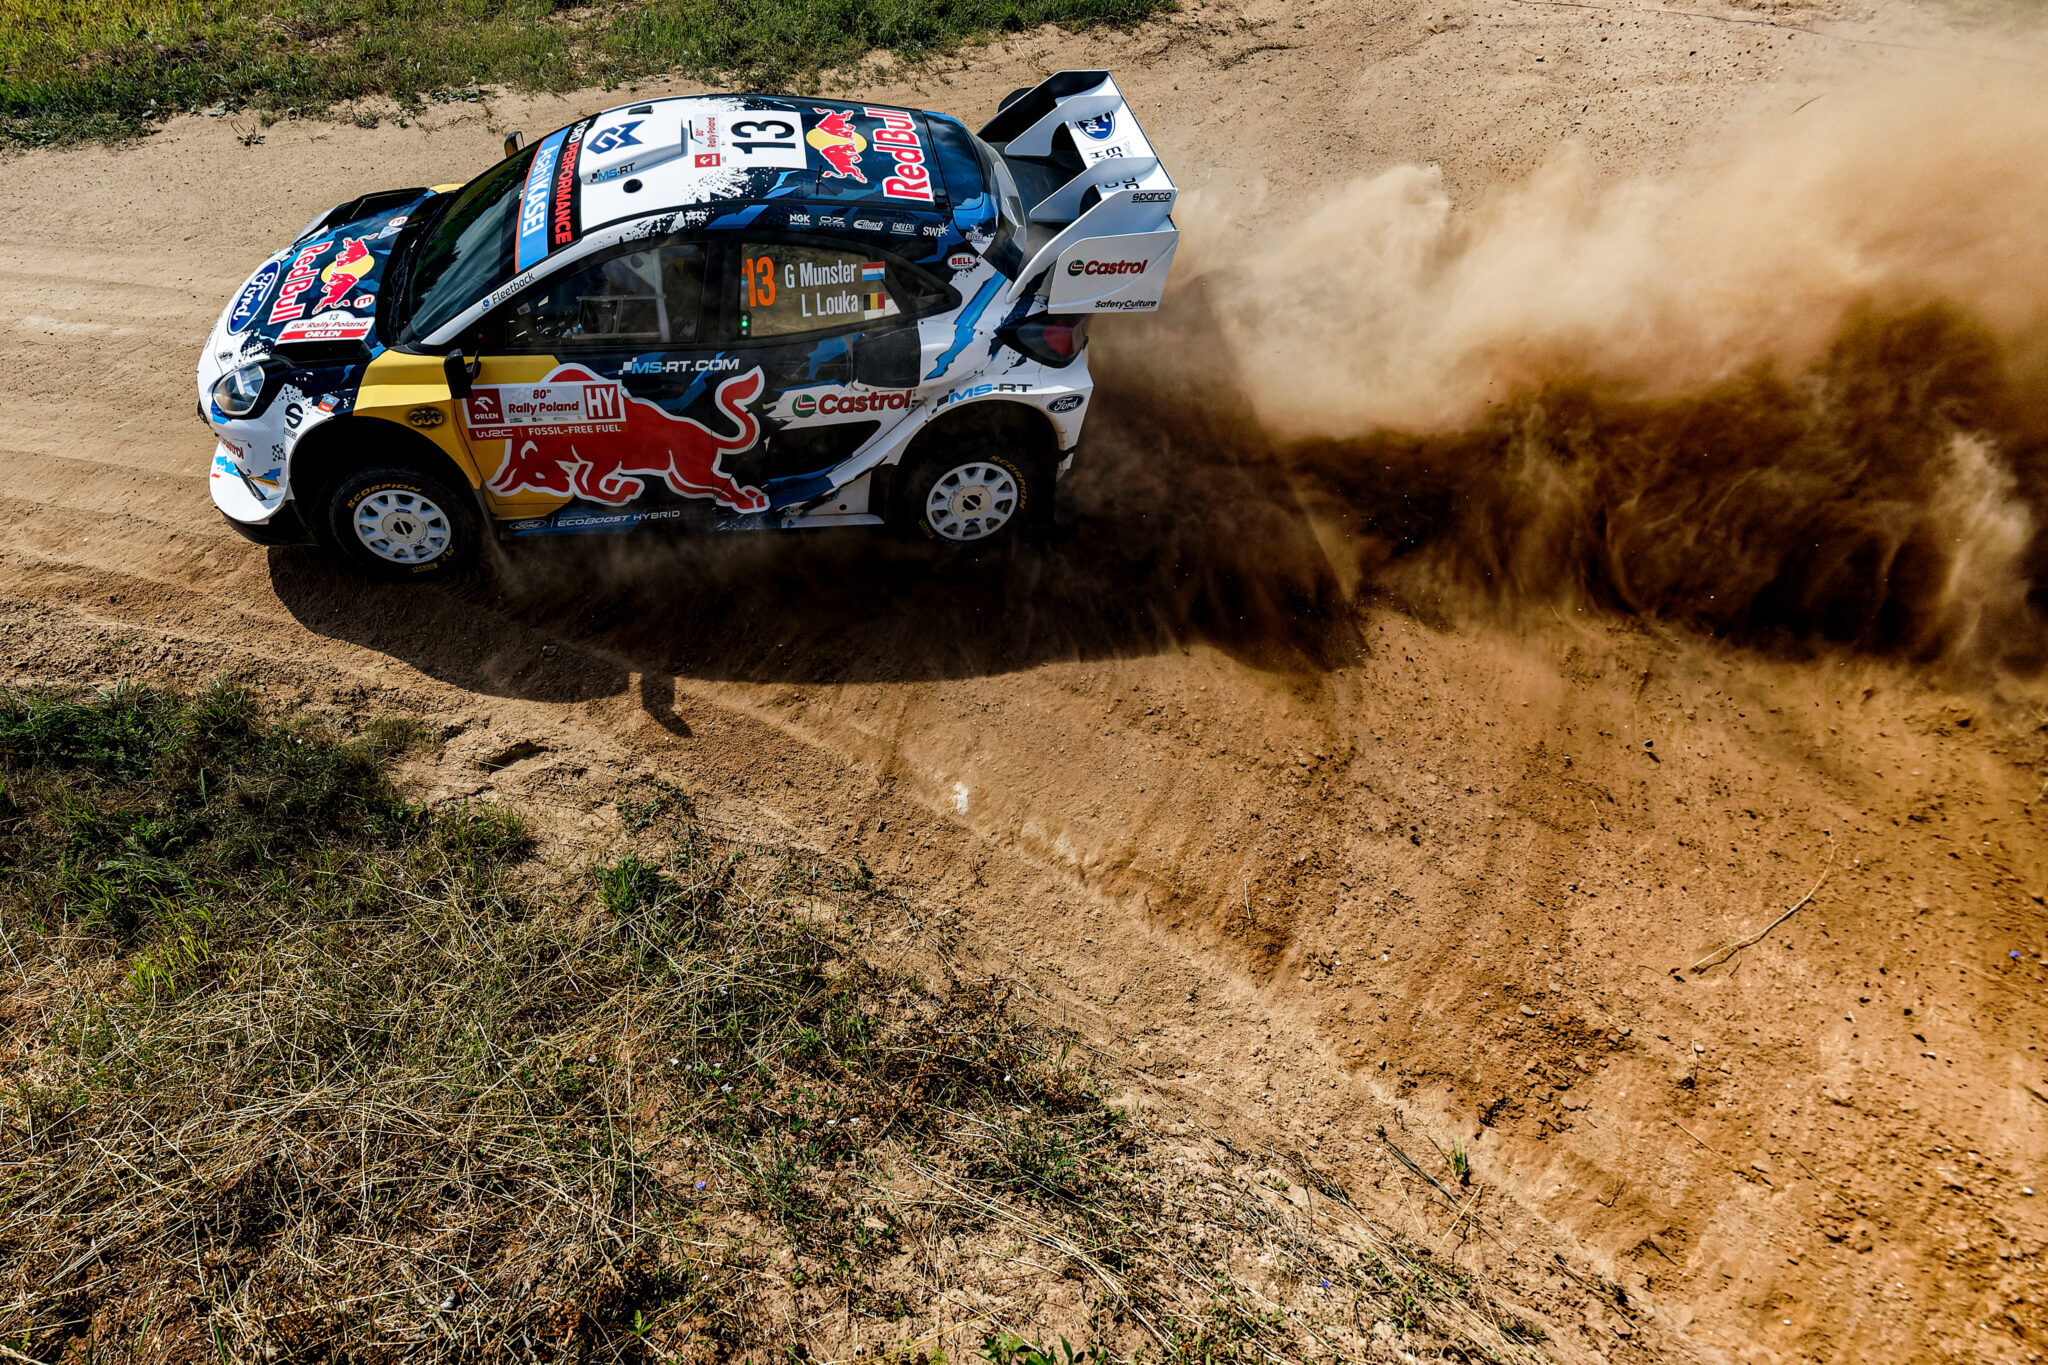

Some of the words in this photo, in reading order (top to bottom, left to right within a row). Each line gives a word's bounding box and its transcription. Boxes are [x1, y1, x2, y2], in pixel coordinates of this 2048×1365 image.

[569, 119, 590, 144] FORD
[730, 120, 797, 154] 13
[555, 142, 580, 245] PERFORMANCE
[1132, 191, 1172, 203] sparco
[789, 213, 811, 223] NGK
[892, 222, 915, 231] ENDLESS
[951, 257, 974, 266] BELL
[1084, 259, 1148, 276] Castrol
[742, 256, 776, 308] 13
[784, 263, 796, 290] G
[800, 259, 857, 288] Munster
[233, 270, 276, 321] Ford
[491, 272, 535, 305] Fleetback
[801, 292, 812, 318] L
[816, 290, 859, 317] Louka
[1095, 299, 1157, 310] SafetyCulture
[307, 322, 332, 330] Rally
[332, 320, 368, 328] Poland
[329, 313, 340, 321] 13
[304, 330, 343, 338] ORLEN
[631, 357, 741, 375] MS-RT.COM
[819, 389, 912, 415] Castrol
[949, 383, 1034, 405] MS-RT
[508, 402, 538, 416] Rally
[539, 400, 579, 413] Poland
[585, 387, 615, 418] HY
[1054, 398, 1080, 412] Ford
[474, 412, 499, 420] ORLEN
[475, 429, 514, 438] WRC
[528, 425, 594, 436] FOSSIL-FREE
[596, 424, 622, 433] FUEL
[988, 455, 1029, 510] SCORPION
[347, 483, 423, 508] SCORPION
[633, 510, 681, 521] HYBRID
[515, 519, 541, 529] Ford
